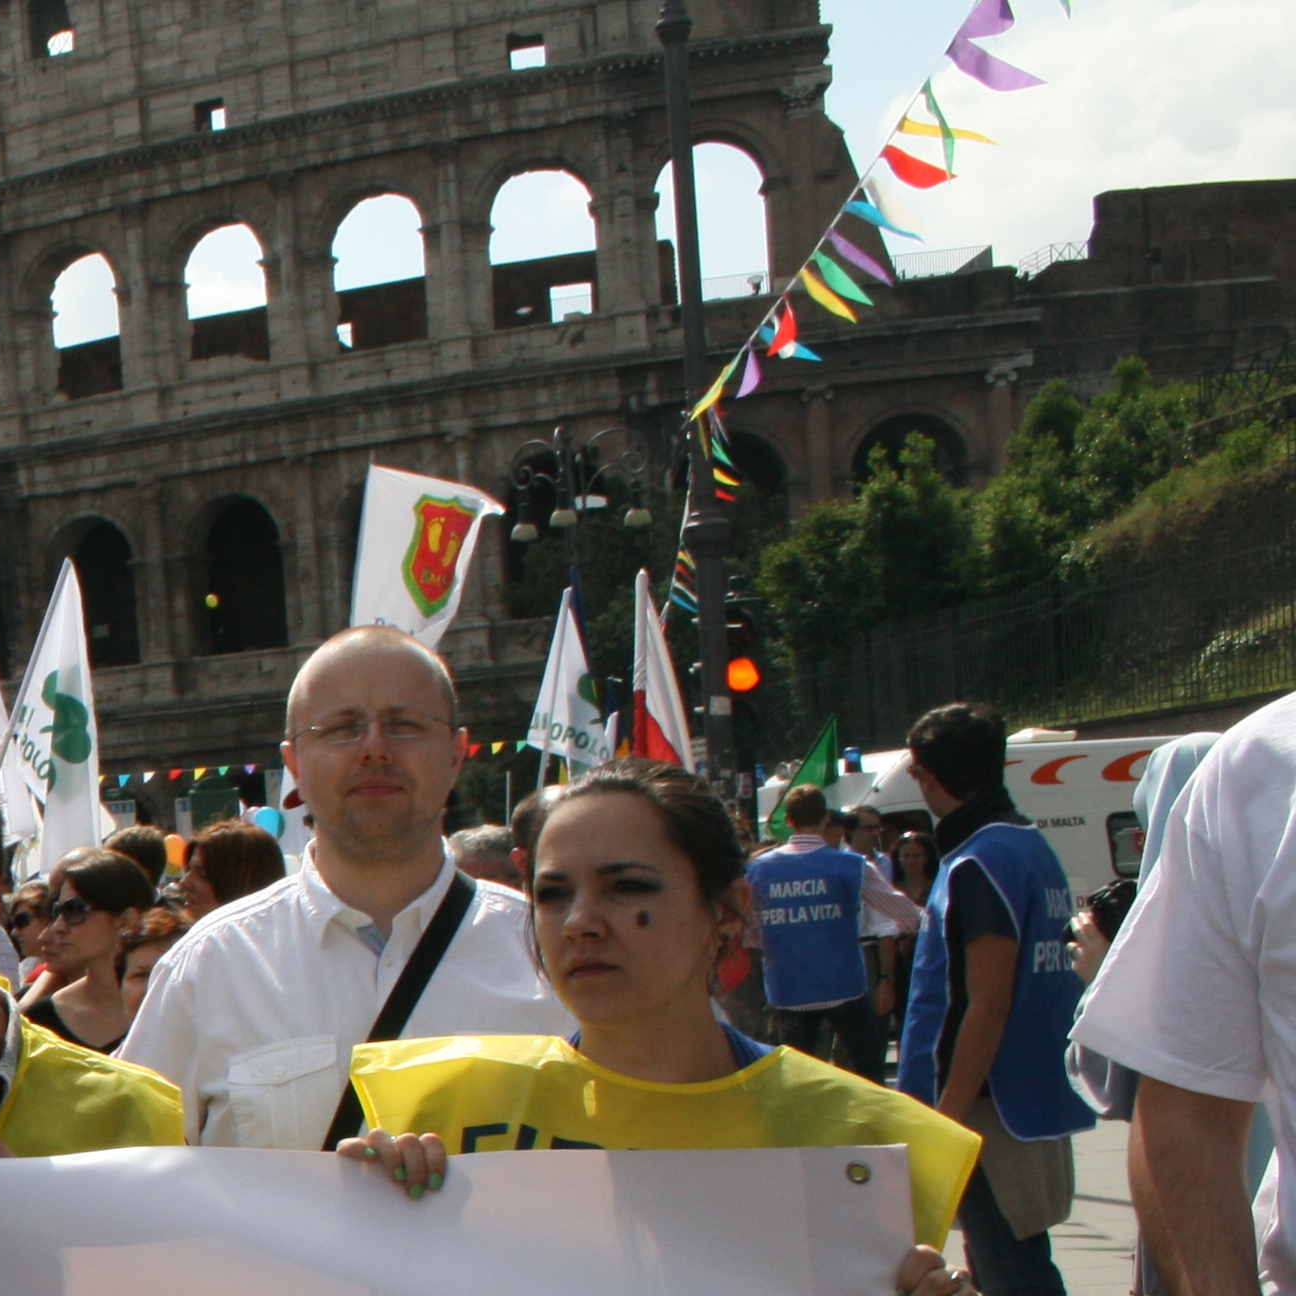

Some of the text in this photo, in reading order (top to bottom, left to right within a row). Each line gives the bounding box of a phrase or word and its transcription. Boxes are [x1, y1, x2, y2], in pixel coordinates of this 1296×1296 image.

[550, 722, 611, 761] OPOLO
[1037, 816, 1086, 829] DI MALTA
[769, 879, 827, 899] MARCIA
[760, 903, 842, 926] PER LA VITA
[1033, 940, 1060, 973] PER
